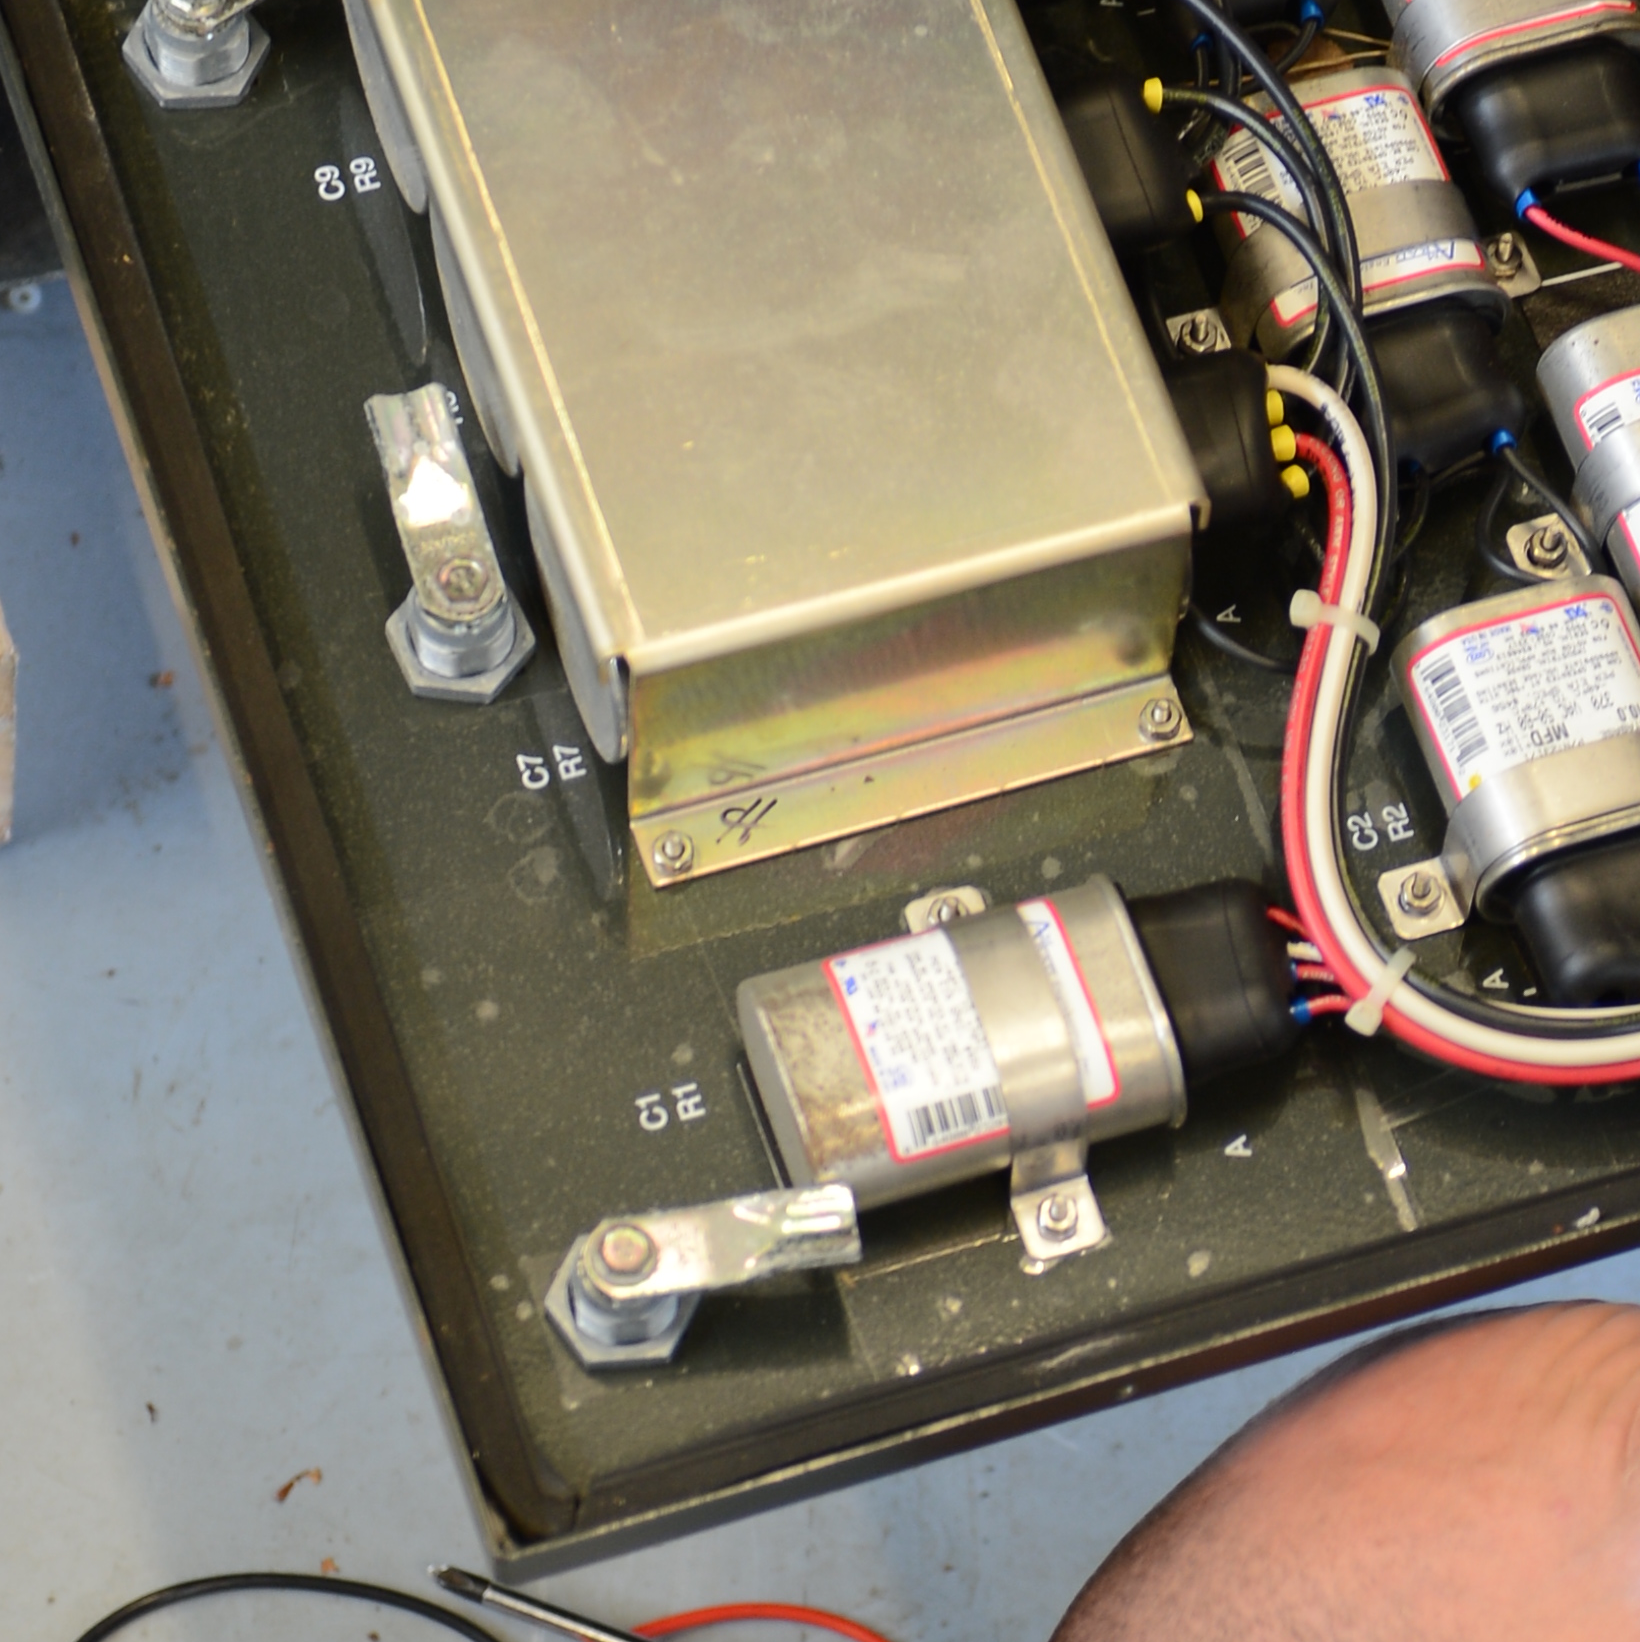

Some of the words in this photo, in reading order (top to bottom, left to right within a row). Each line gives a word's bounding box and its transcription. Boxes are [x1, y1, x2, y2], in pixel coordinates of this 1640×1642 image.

[314, 165, 346, 201] C9
[349, 156, 382, 194] R9
[1529, 721, 1568, 747] MFD
[516, 754, 550, 790] C7
[552, 744, 587, 781] R7
[1346, 811, 1377, 851] C2
[1380, 802, 1415, 843] R2
[1482, 968, 1510, 989] A
[634, 1093, 669, 1131] C1
[671, 1082, 706, 1122] R1
[1223, 1134, 1253, 1158] A
